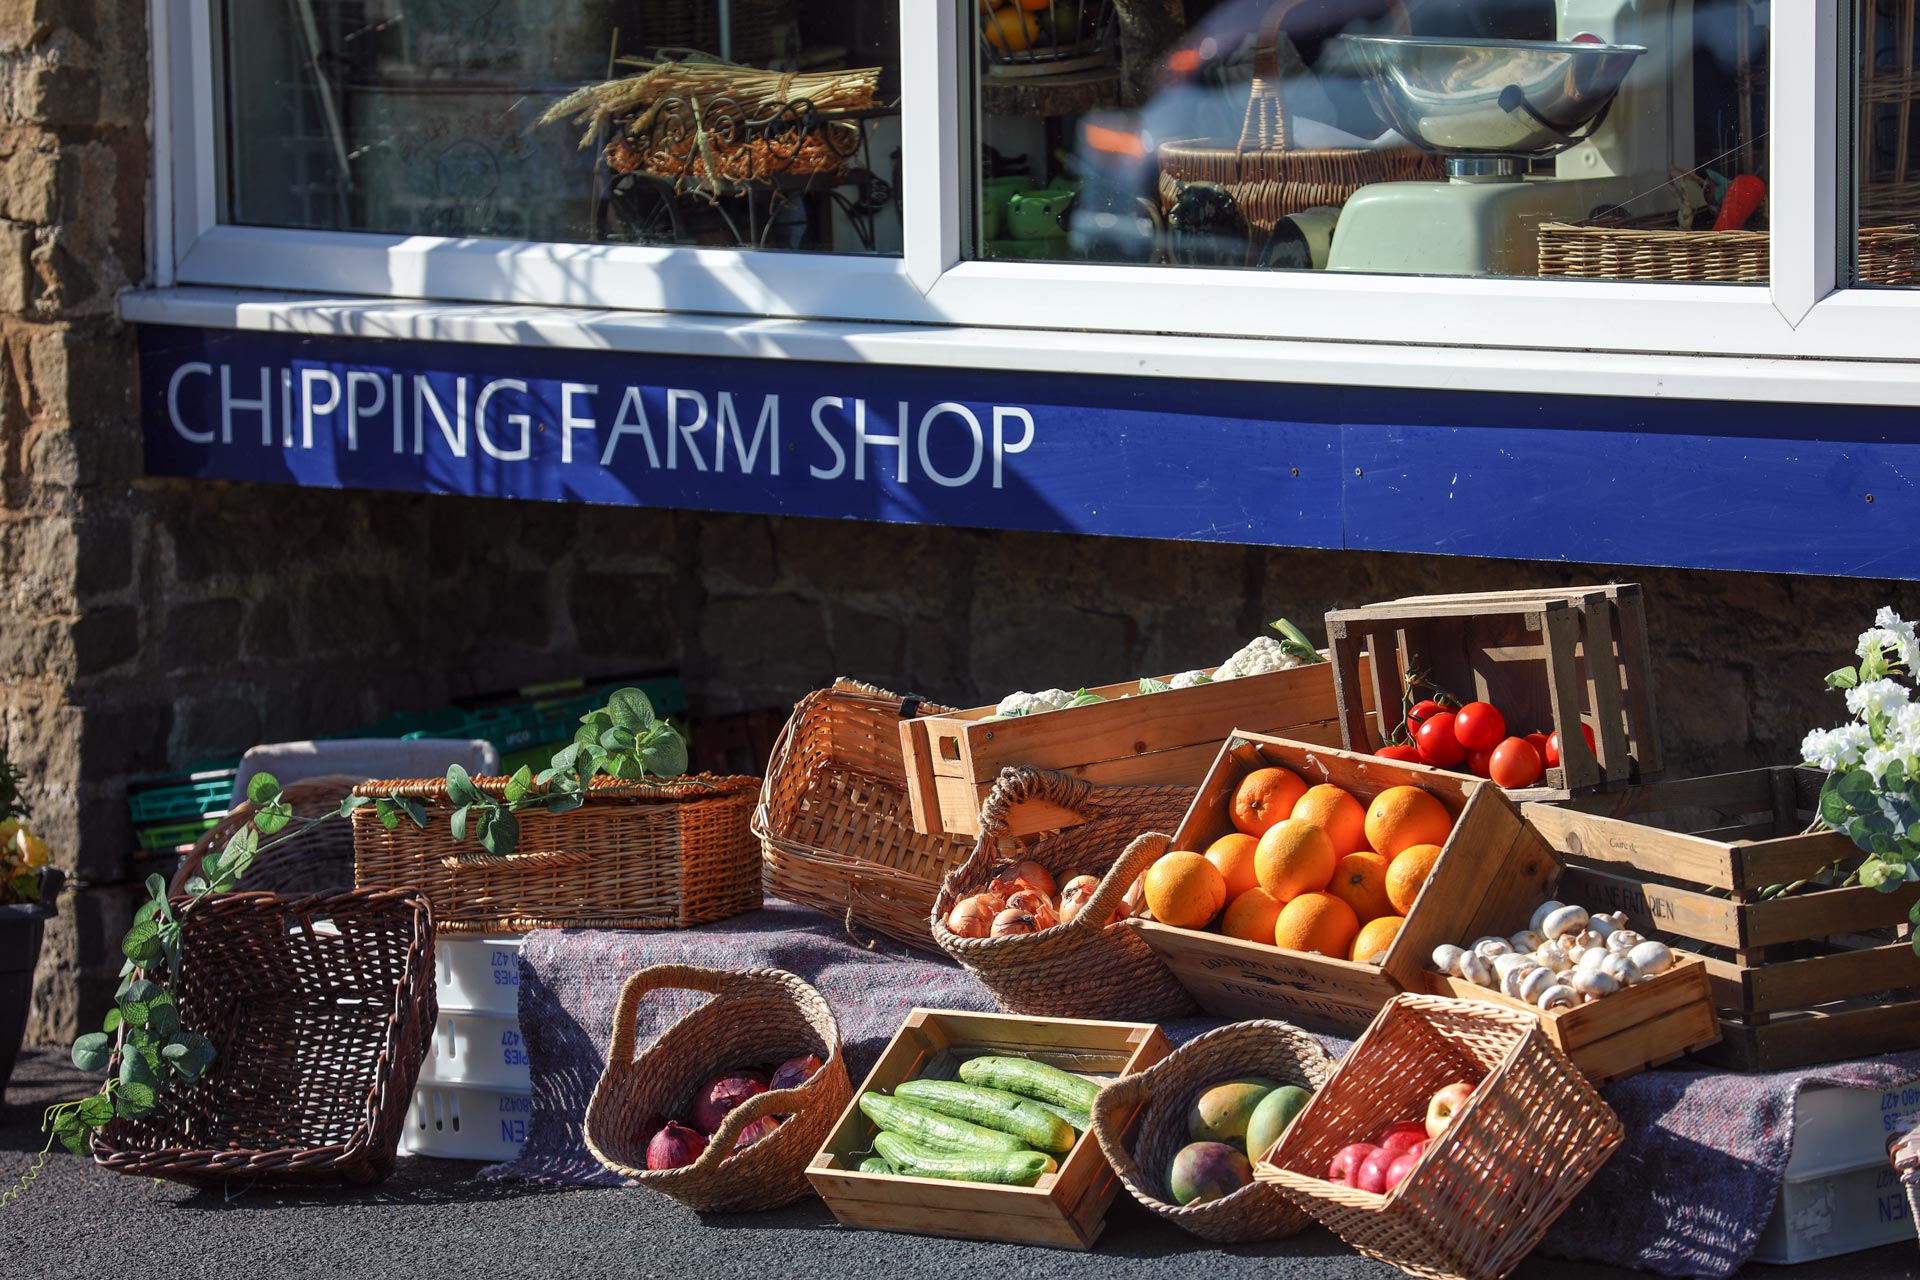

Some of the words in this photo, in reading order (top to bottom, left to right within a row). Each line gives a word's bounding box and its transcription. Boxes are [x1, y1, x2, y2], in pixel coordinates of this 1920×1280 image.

[166, 361, 531, 462] CHIPPING
[560, 382, 781, 476] FARM
[809, 396, 1035, 490] SHOP
[1648, 895, 1675, 921] RIEN
[491, 951, 509, 967] 427
[1200, 958, 1268, 970] LONDON
[494, 970, 519, 985] PIES
[1221, 982, 1298, 1005] FRESH
[501, 1031, 519, 1046] 427
[503, 1049, 529, 1065] PIES
[1881, 1093, 1899, 1110] 427
